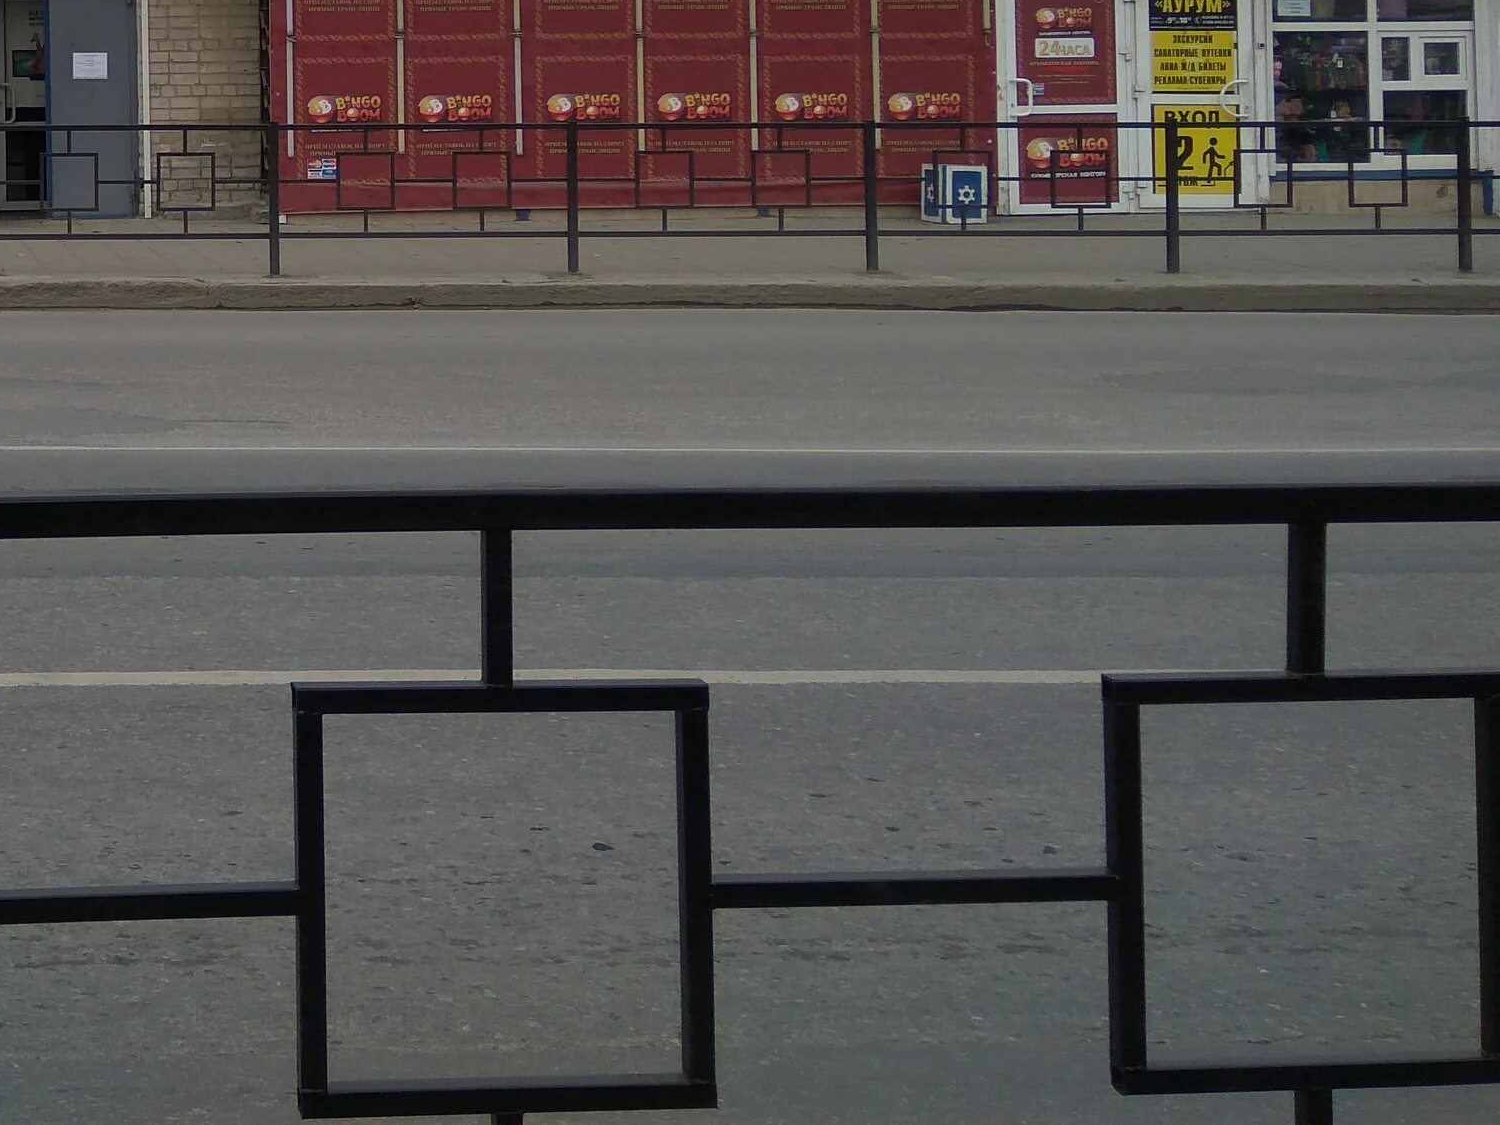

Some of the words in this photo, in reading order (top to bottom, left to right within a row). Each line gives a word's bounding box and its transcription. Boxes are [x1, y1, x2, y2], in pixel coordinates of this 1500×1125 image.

[1172, 35, 1213, 44] ЭКСКУРСИИ
[1154, 49, 1199, 57] САНАТОРНЫЕ
[1202, 49, 1232, 57] ПУТЕВКИ
[1198, 62, 1227, 71] БИЛЕТЫ
